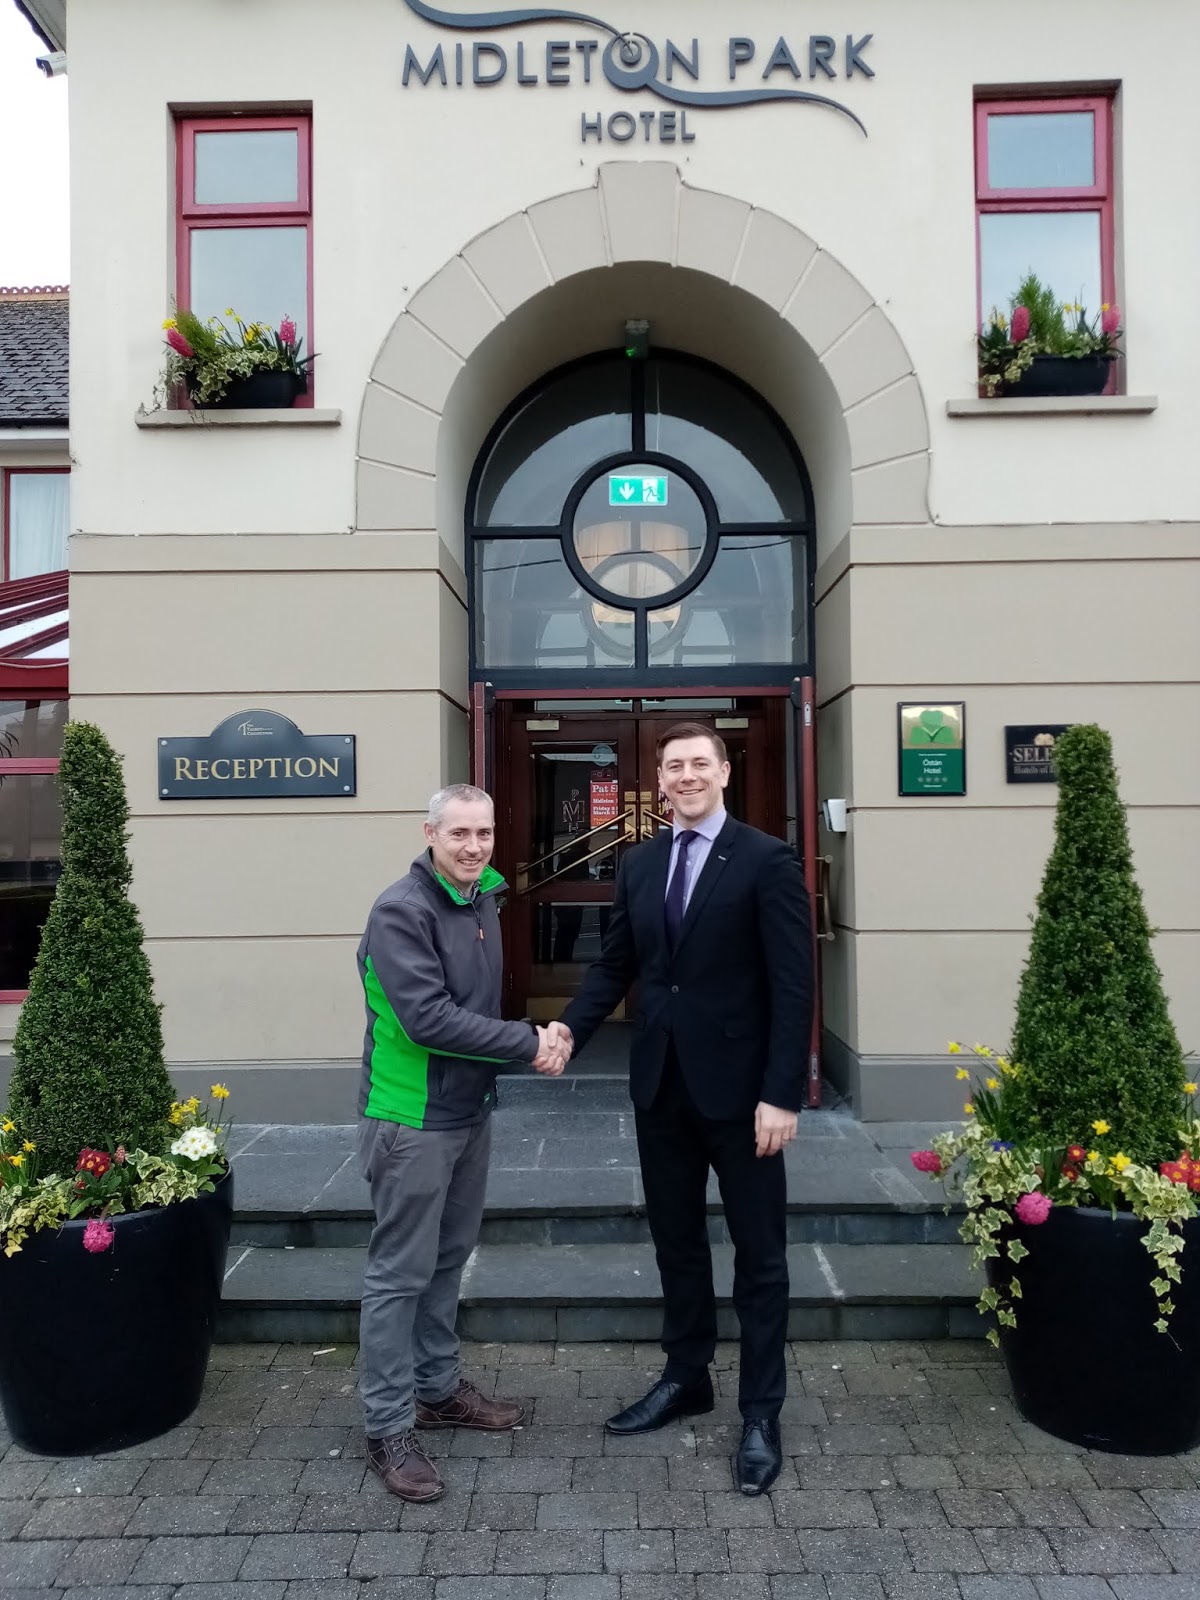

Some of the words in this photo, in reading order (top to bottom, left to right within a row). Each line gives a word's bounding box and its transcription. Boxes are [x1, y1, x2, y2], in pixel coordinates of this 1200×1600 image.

[402, 35, 699, 89] MIDLETON
[729, 33, 876, 80] PARK
[581, 110, 696, 143] HOTEL
[1013, 747, 1056, 763] SELE
[173, 757, 340, 781] RECEPTION
[592, 785, 609, 793] Pat
